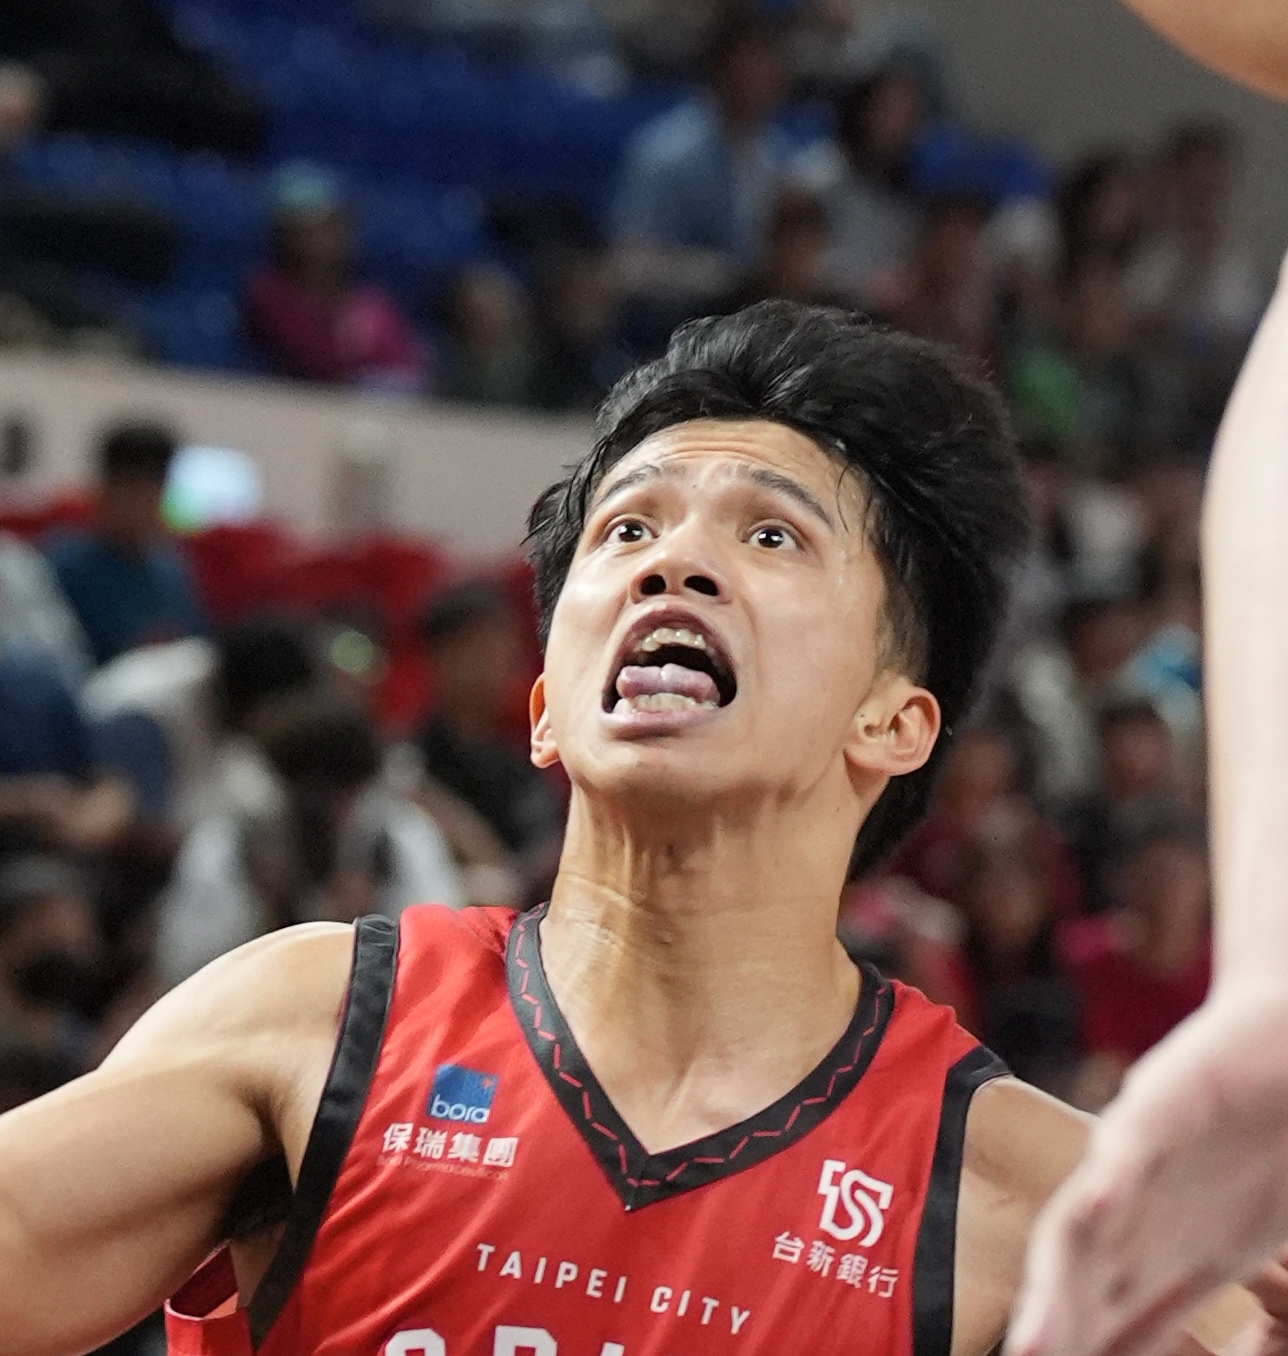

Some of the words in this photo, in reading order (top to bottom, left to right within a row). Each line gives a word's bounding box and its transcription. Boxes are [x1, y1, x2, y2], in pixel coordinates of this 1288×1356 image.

[430, 1094, 490, 1123] bora
[382, 1122, 518, 1168] 保瑞集團
[477, 1243, 627, 1303] TAIPEI
[650, 1286, 750, 1336] CITY
[772, 1231, 900, 1298] 台新銀行
